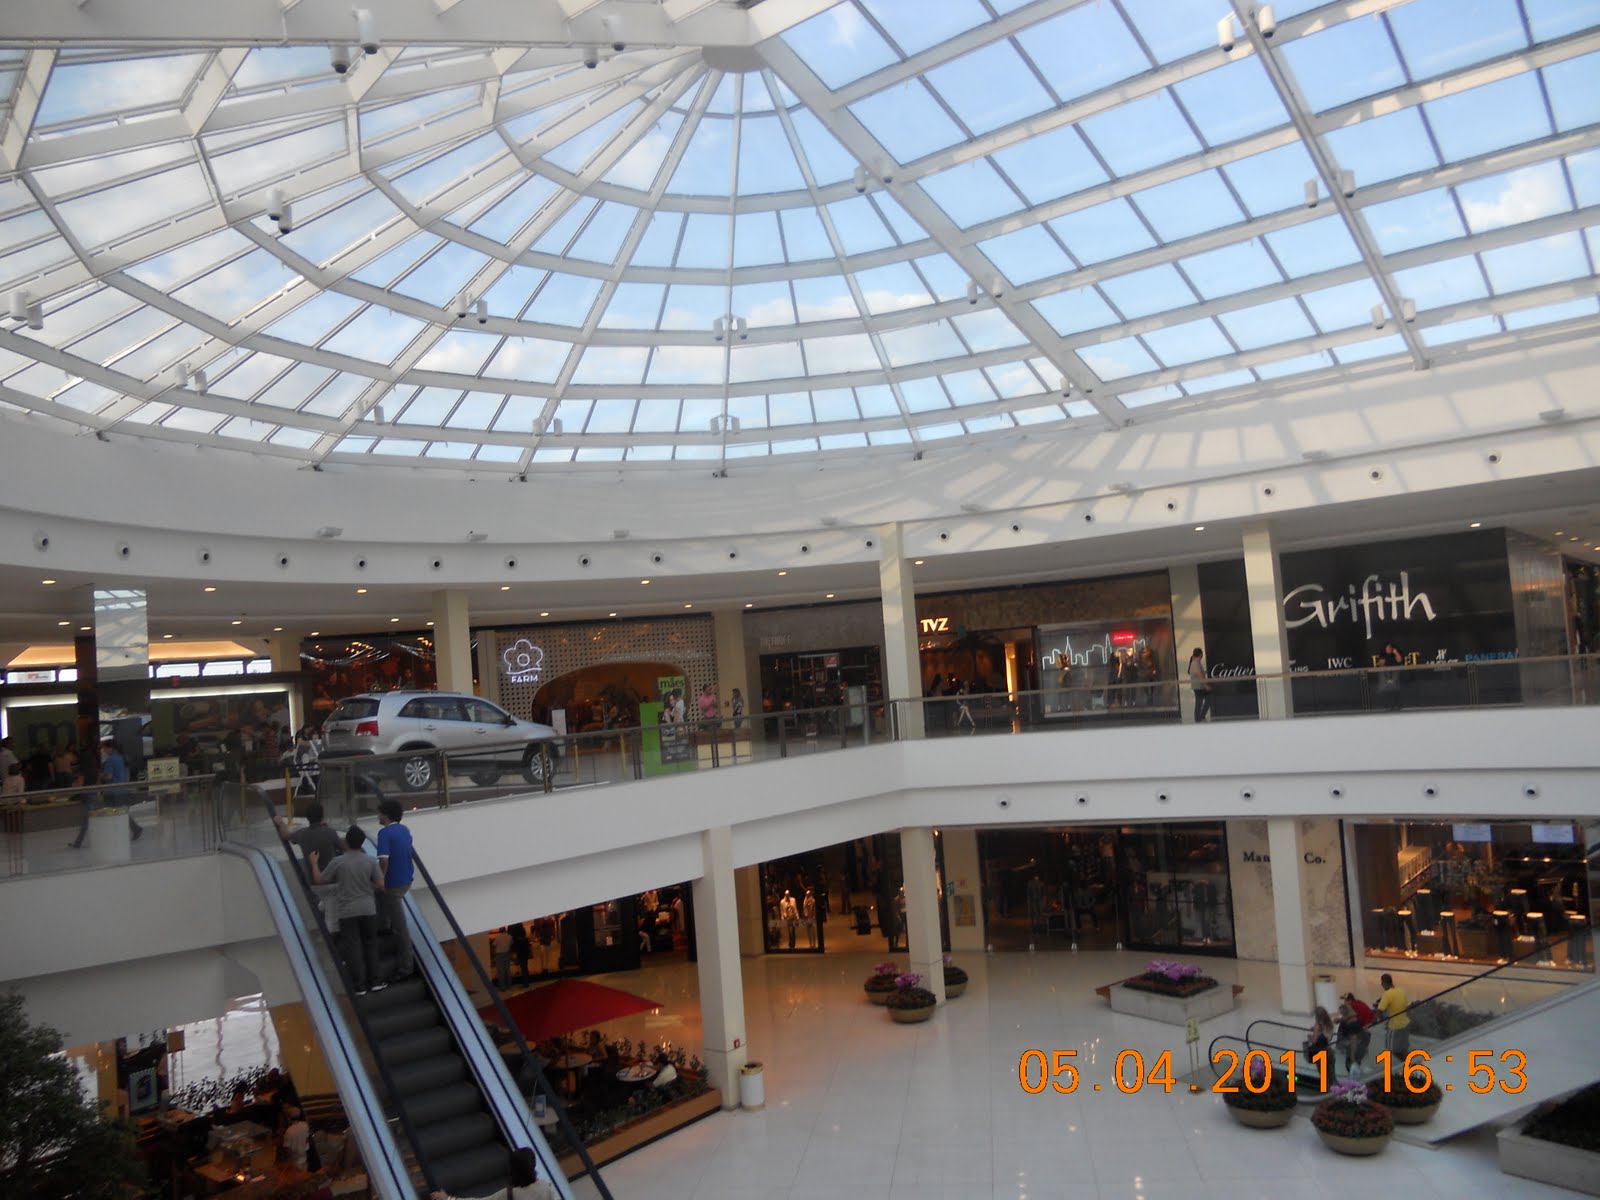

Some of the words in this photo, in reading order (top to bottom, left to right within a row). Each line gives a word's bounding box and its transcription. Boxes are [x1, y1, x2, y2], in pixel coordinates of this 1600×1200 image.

[1283, 570, 1437, 640] Grifith
[920, 617, 949, 633] TVZ
[1327, 656, 1353, 670] IWC
[511, 674, 539, 684] FARM
[1243, 850, 1271, 863] Man
[1303, 851, 1327, 864] Co.
